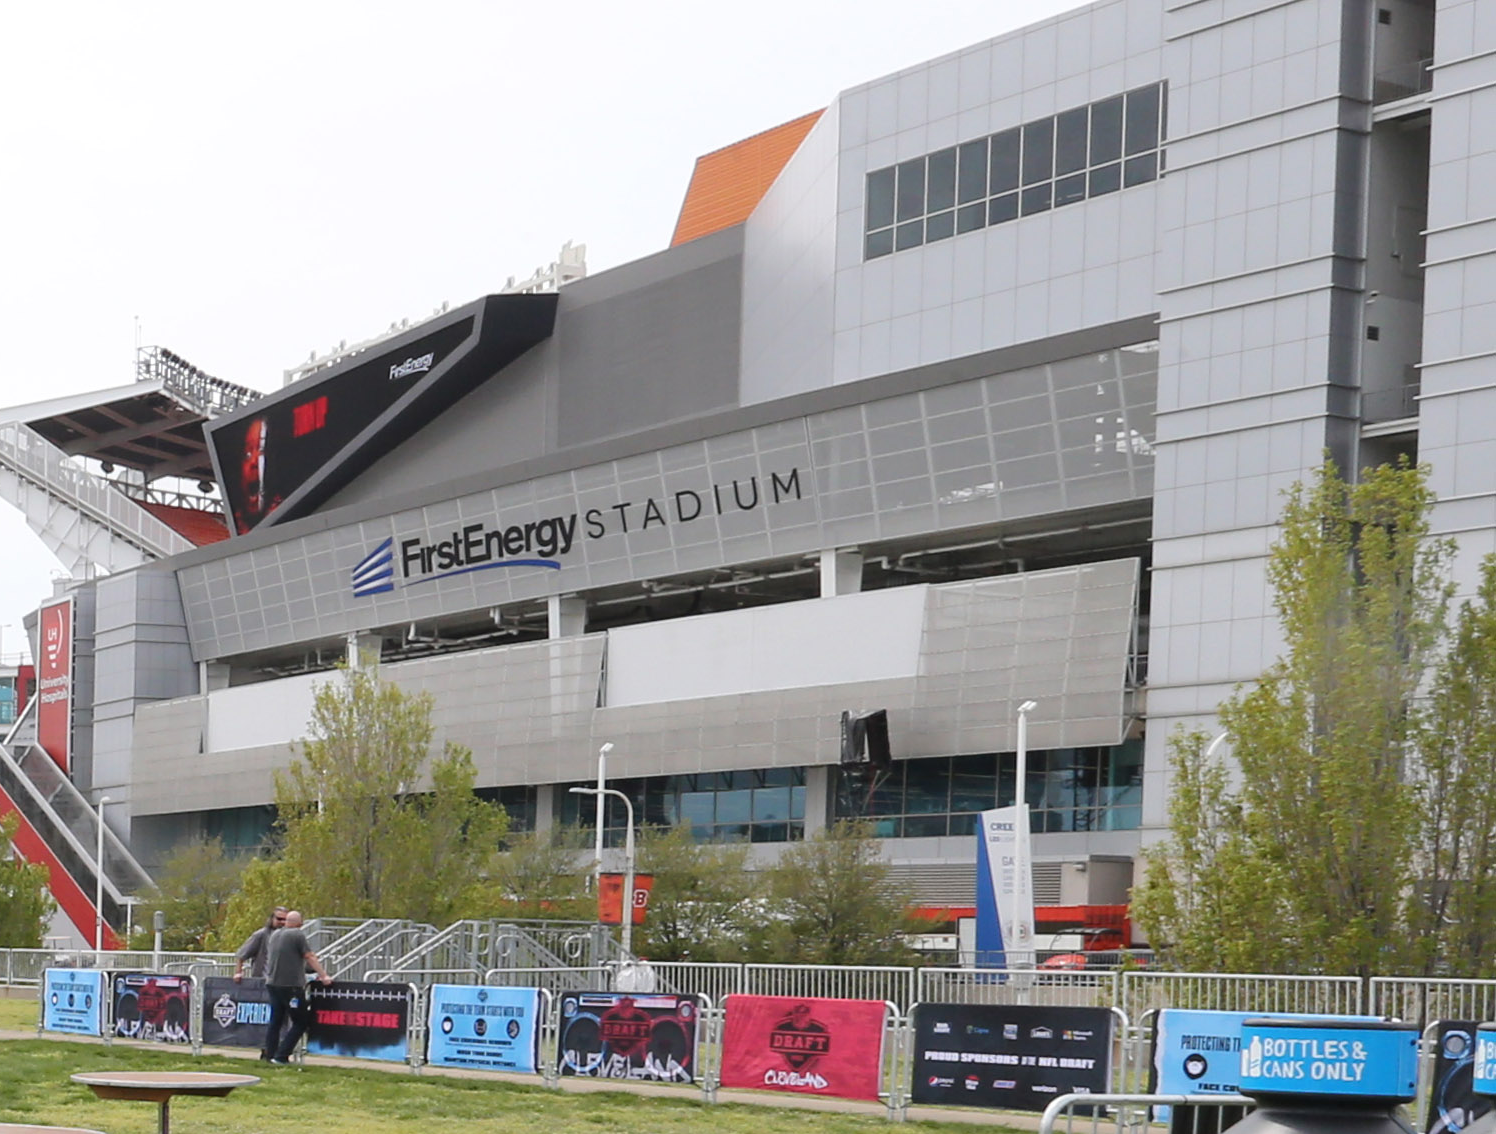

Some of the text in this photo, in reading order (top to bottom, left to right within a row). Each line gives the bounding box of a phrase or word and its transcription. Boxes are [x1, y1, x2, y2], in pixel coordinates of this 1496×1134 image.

[389, 352, 434, 380] FirstEnergy
[401, 467, 802, 578] FirstEnergy STADIUM
[40, 674, 69, 690] University
[633, 888, 649, 908] B
[236, 1002, 271, 1025] EXPERIEN
[316, 1010, 345, 1026] TAKE
[355, 1012, 400, 1029] STAGE
[603, 1023, 648, 1037] DRAFT
[773, 1034, 827, 1050] DRAFT
[1181, 1034, 1231, 1052] PROTECTING
[1263, 1038, 1368, 1060] BOTTLES &
[924, 1051, 959, 1062] PROUD
[961, 1053, 1019, 1065] SPONSORS
[1038, 1056, 1058, 1067] NFL
[1059, 1058, 1095, 1069] DRAFT
[764, 1069, 829, 1089] CLEVELAND
[1262, 1060, 1365, 1082] CANS ONLY
[1198, 1083, 1220, 1091] FACE
